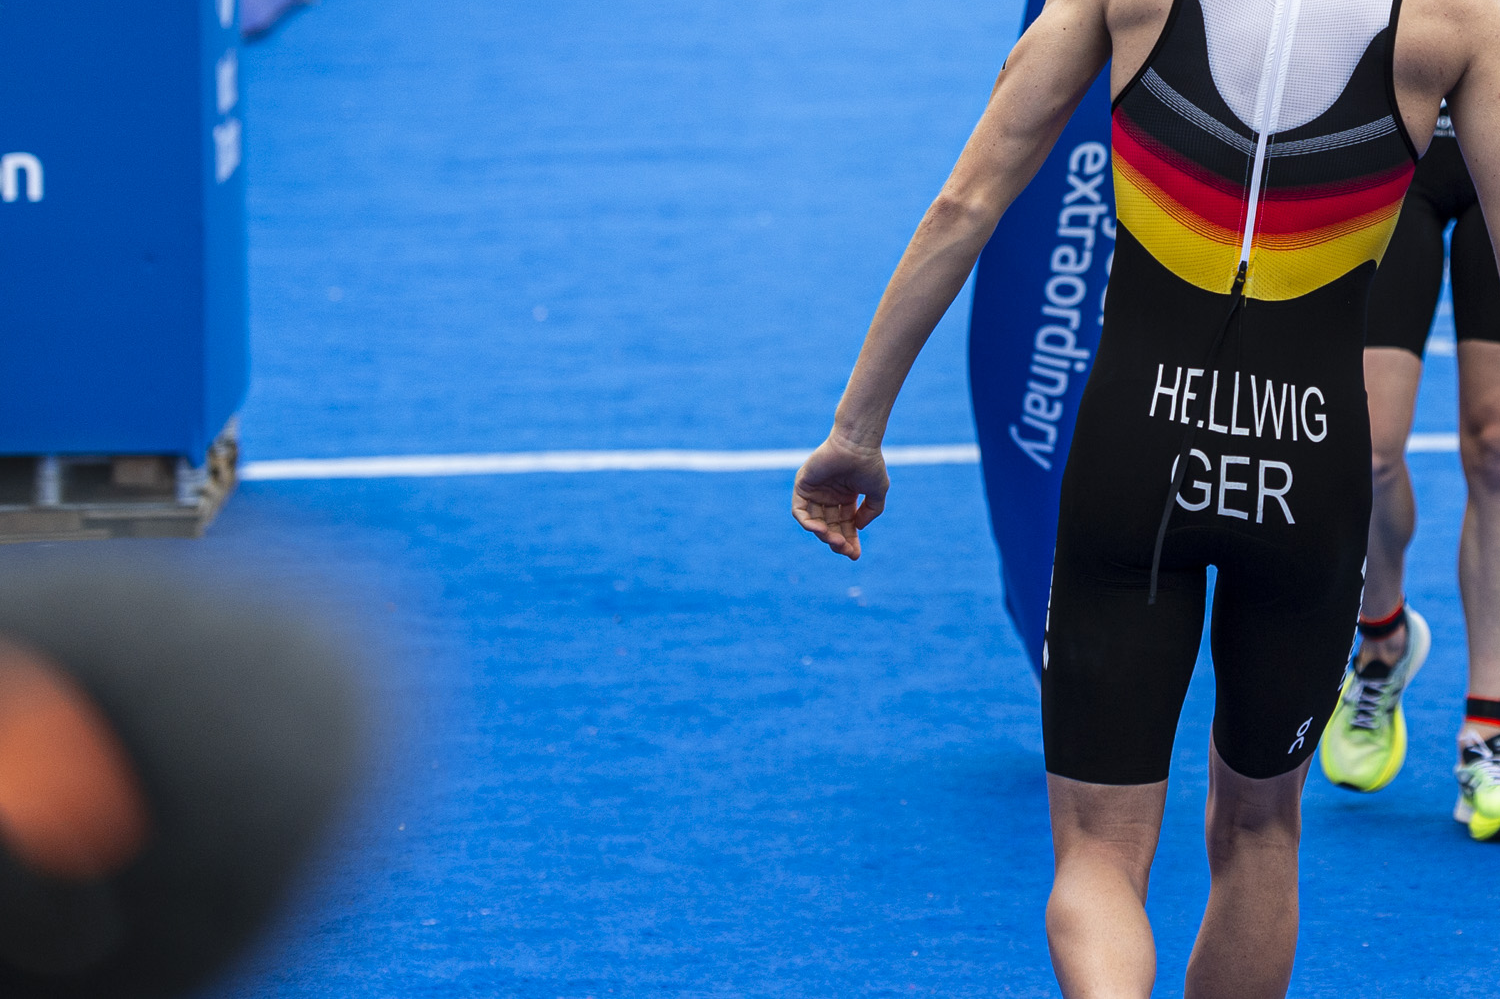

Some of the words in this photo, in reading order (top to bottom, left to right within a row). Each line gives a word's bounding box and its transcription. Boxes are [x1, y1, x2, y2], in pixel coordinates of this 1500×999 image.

[1008, 141, 1108, 470] extraordinary
[1149, 363, 1328, 443] HELLWIG
[1170, 448, 1296, 525] GER
